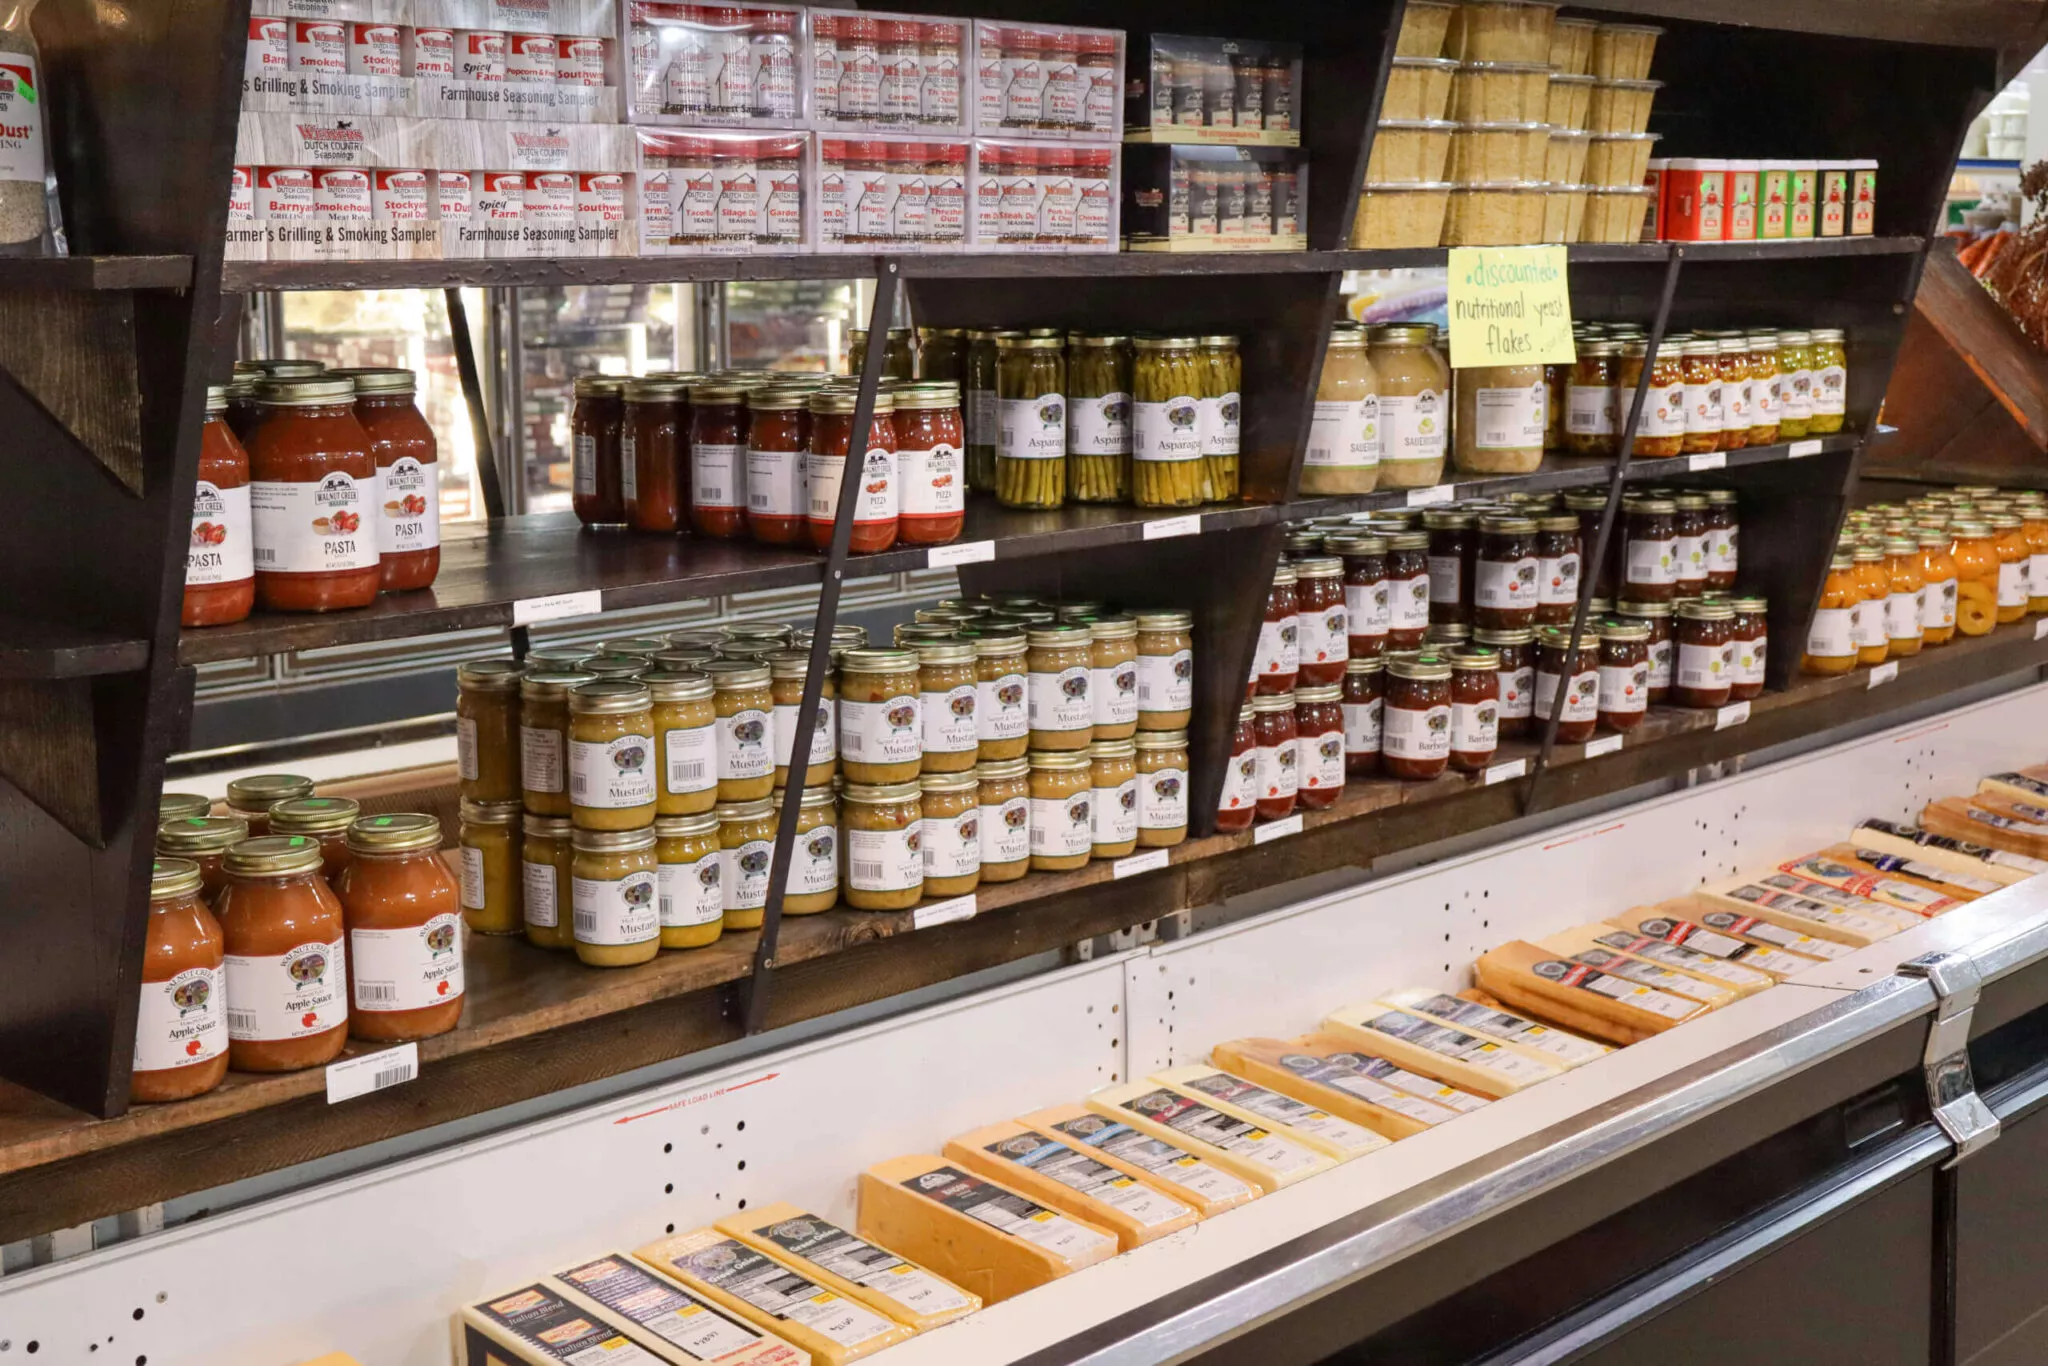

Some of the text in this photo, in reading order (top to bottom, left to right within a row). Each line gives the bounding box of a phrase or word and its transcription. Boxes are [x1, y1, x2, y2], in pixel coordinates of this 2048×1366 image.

[300, 56, 345, 68] Smokeho
[462, 61, 492, 74] Spicy
[476, 71, 503, 81] Farm
[253, 77, 297, 97] Grilling
[300, 81, 309, 94] &
[312, 79, 361, 99] Smoking
[365, 81, 411, 99] Sampler
[440, 85, 600, 107] Farmhouse Seasoning Sampler
[304, 141, 364, 151] DUTCH COUNTRY
[517, 148, 537, 157] DUTCH
[314, 150, 354, 161] Seasonings
[478, 200, 507, 212] Spicy
[491, 209, 518, 219] Farm
[226, 226, 437, 245] armer's Grilling & Smoking Sampler
[459, 226, 620, 243] Farmhouse Seasoning Sampler
[1455, 291, 1564, 327] nutritional yeast
[1485, 323, 1532, 354] flakes
[389, 476, 424, 486] WALNUT CREEK
[316, 491, 358, 503] WALNUT CREEK
[870, 495, 886, 505] PIZZA
[936, 489, 952, 499] PIZZA
[395, 523, 423, 536] PASTA
[324, 540, 356, 554] PASTA
[187, 552, 222, 567] PASTA
[729, 757, 769, 769] Mustard
[608, 782, 652, 798] Mustard
[419, 914, 443, 938] WALNUT
[619, 918, 657, 935] Mustard
[279, 943, 309, 968] WALNUT
[422, 962, 459, 981] Apple Sauce
[163, 967, 215, 994] WALNUT CREEK
[285, 993, 332, 1012] Apple Sauce
[168, 1019, 217, 1040] Apple Sauce
[668, 1088, 726, 1110] SAFE LOAD LINE
[788, 1227, 842, 1253] Green Onion
[707, 1253, 763, 1284] Green Onion
[508, 1310, 540, 1326] Italian
[539, 1299, 566, 1315] Blend
[556, 1338, 589, 1356] Italian
[588, 1329, 614, 1345] Blend
